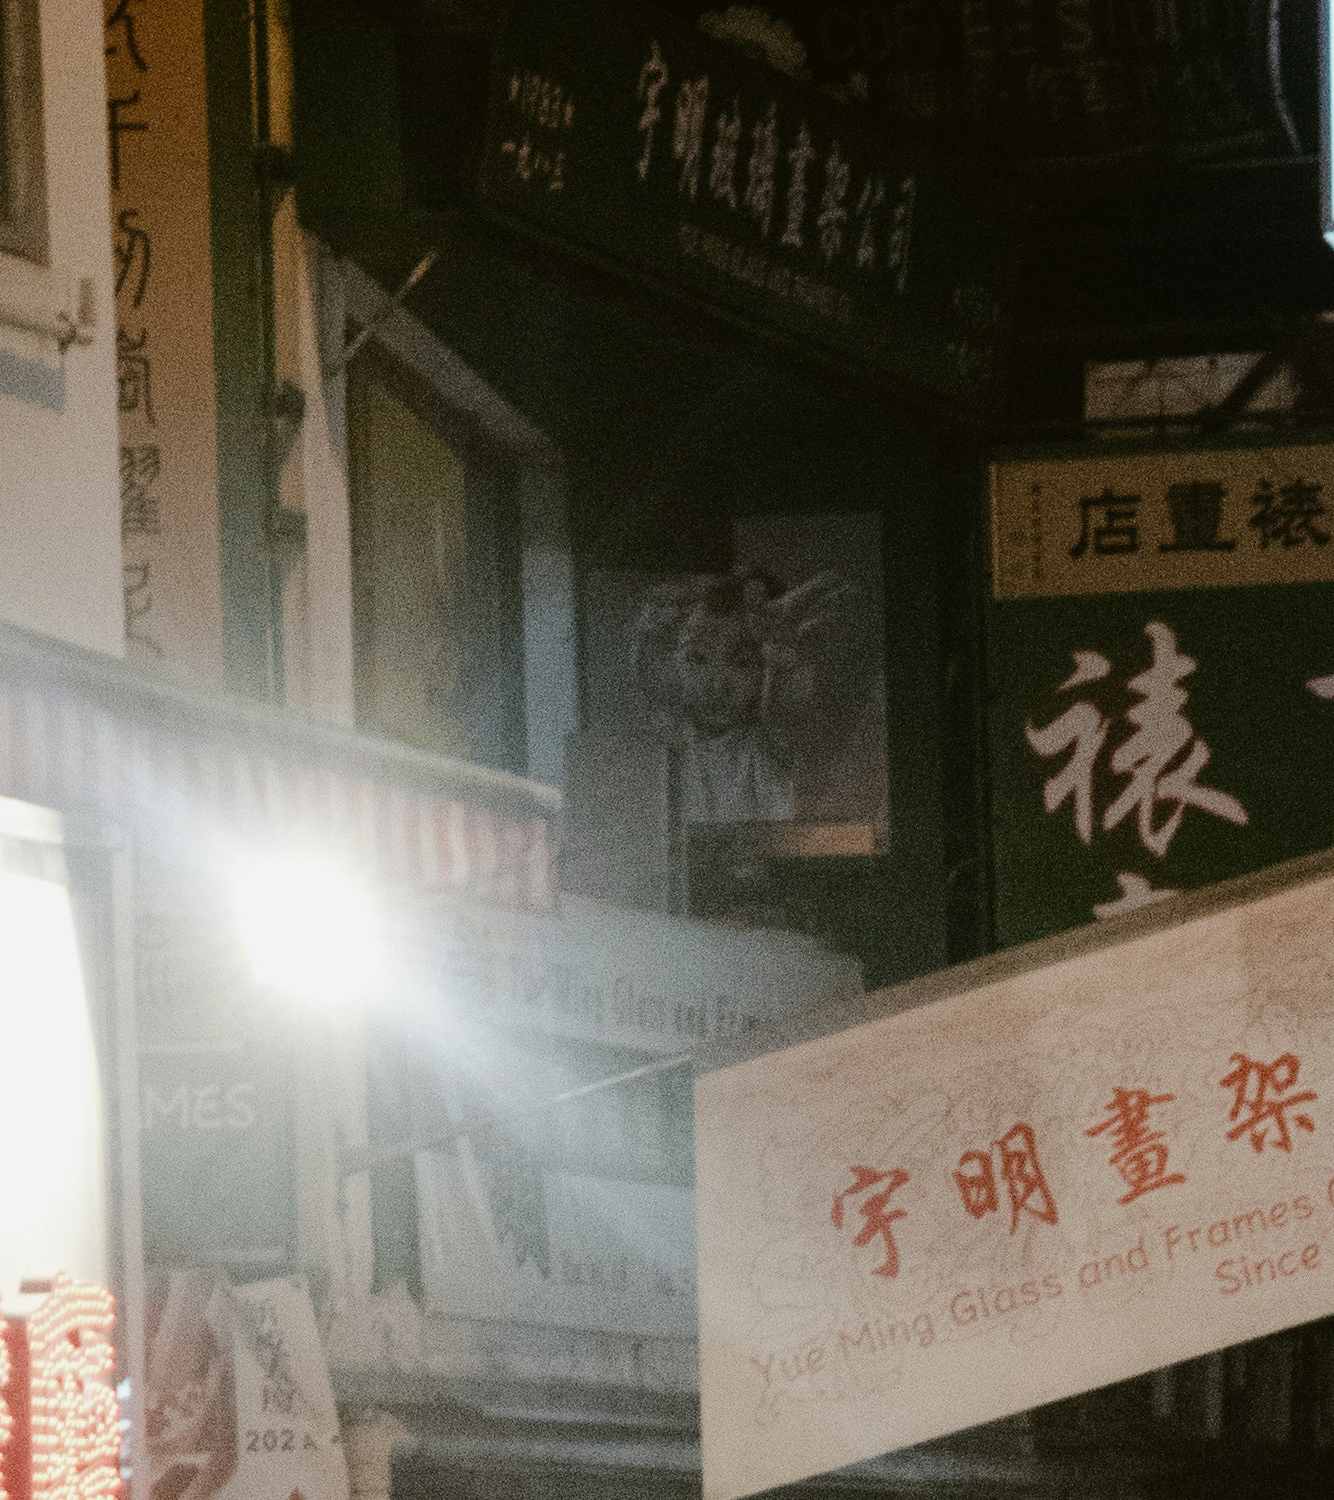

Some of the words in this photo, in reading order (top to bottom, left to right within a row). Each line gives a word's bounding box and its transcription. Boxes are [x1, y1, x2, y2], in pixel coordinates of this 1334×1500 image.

[834, 1298, 938, 1366] Ming
[947, 1266, 1064, 1332] Glass
[1076, 1233, 1151, 1285] and
[1162, 1193, 1320, 1273] Frames
[1214, 1236, 1324, 1300] Since
